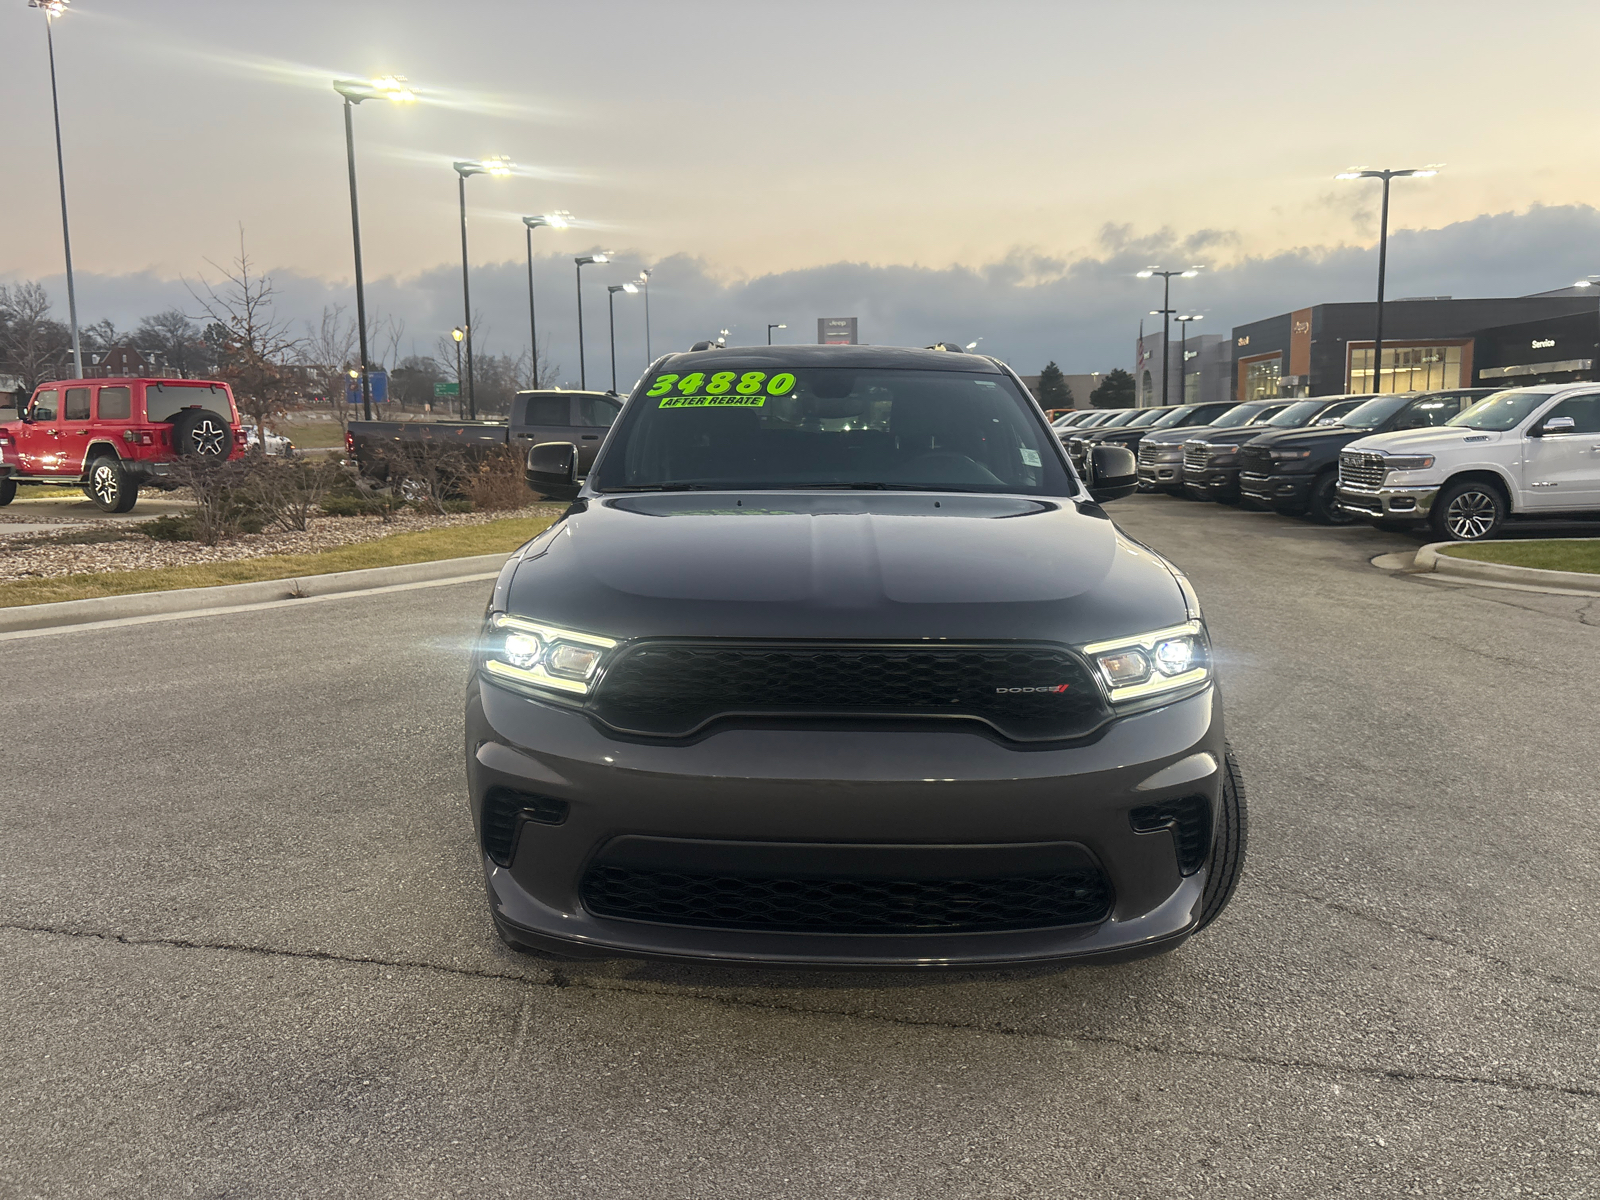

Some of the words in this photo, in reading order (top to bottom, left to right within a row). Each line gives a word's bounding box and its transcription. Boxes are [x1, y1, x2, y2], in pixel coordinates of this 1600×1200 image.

[1531, 338, 1555, 349] Service
[646, 371, 796, 397] 34880
[662, 397, 707, 407] AFTER
[708, 396, 763, 406] REBATE
[996, 685, 1060, 694] DODGE
